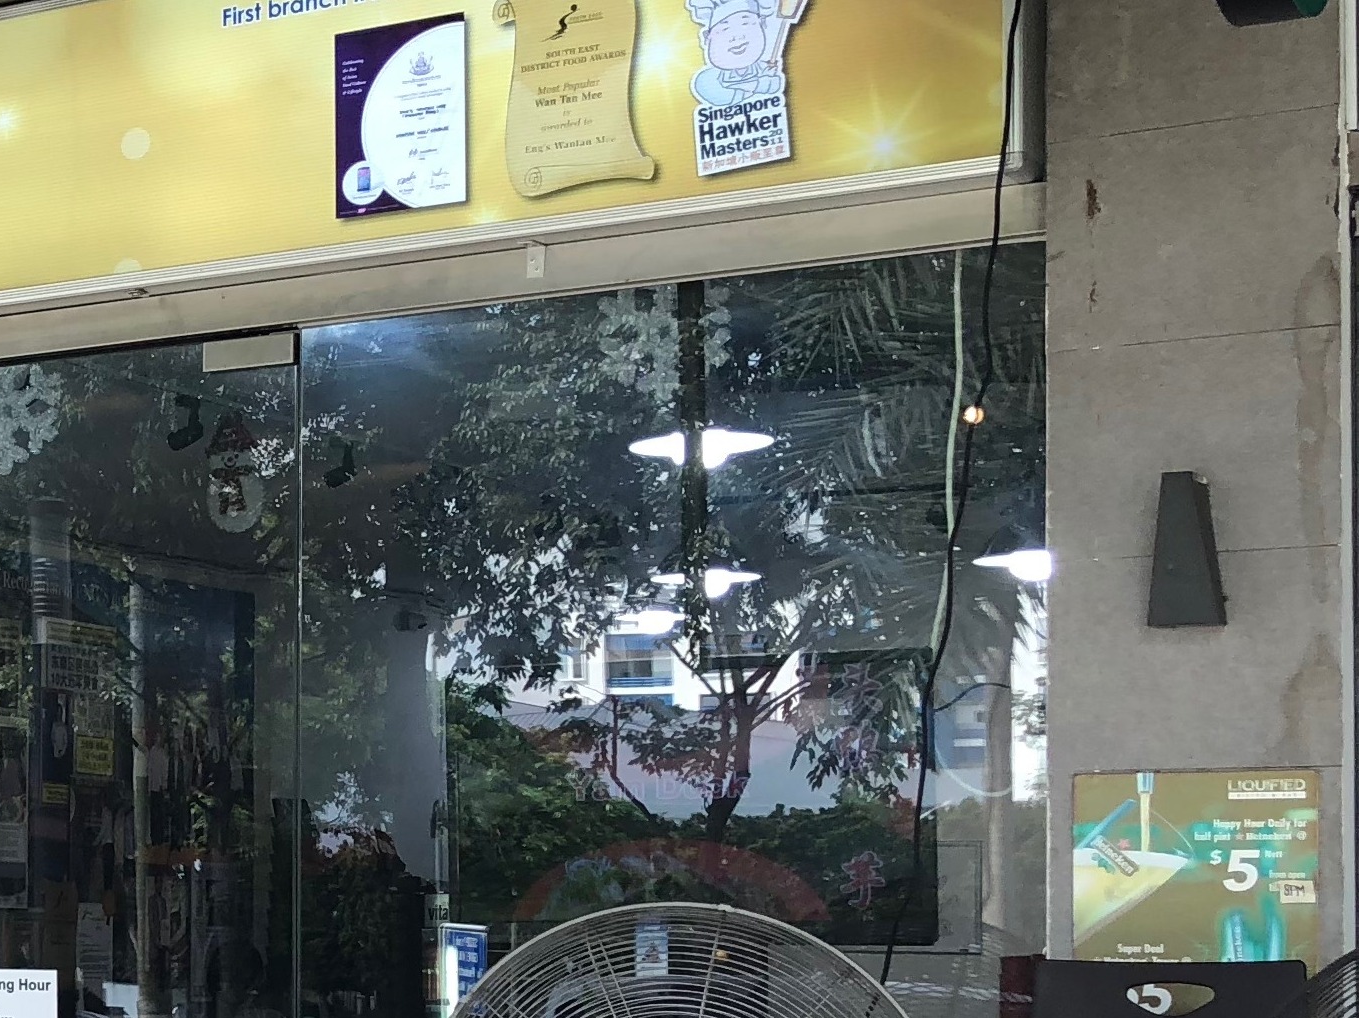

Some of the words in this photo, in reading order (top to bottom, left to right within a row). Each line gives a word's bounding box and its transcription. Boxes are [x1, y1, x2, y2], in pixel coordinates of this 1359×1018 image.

[222, 3, 261, 26] First
[269, 0, 346, 18] branc
[578, 44, 600, 54] EAST
[521, 60, 560, 73] DISTRICT
[563, 56, 587, 67] FOOD
[589, 50, 627, 62] AWARDS
[538, 85, 560, 96] Most
[563, 79, 600, 92] Popular
[535, 98, 556, 107] Wan
[560, 94, 578, 103] Tan
[582, 91, 602, 101] Mee
[698, 96, 780, 123] Singapore
[699, 112, 782, 144] Hawker
[701, 135, 769, 159] Masters
[1268, 818, 1291, 830] Daily
[1117, 944, 1141, 955] Super
[1144, 944, 1164, 953] Deal
[18, 979, 51, 991] Hour
